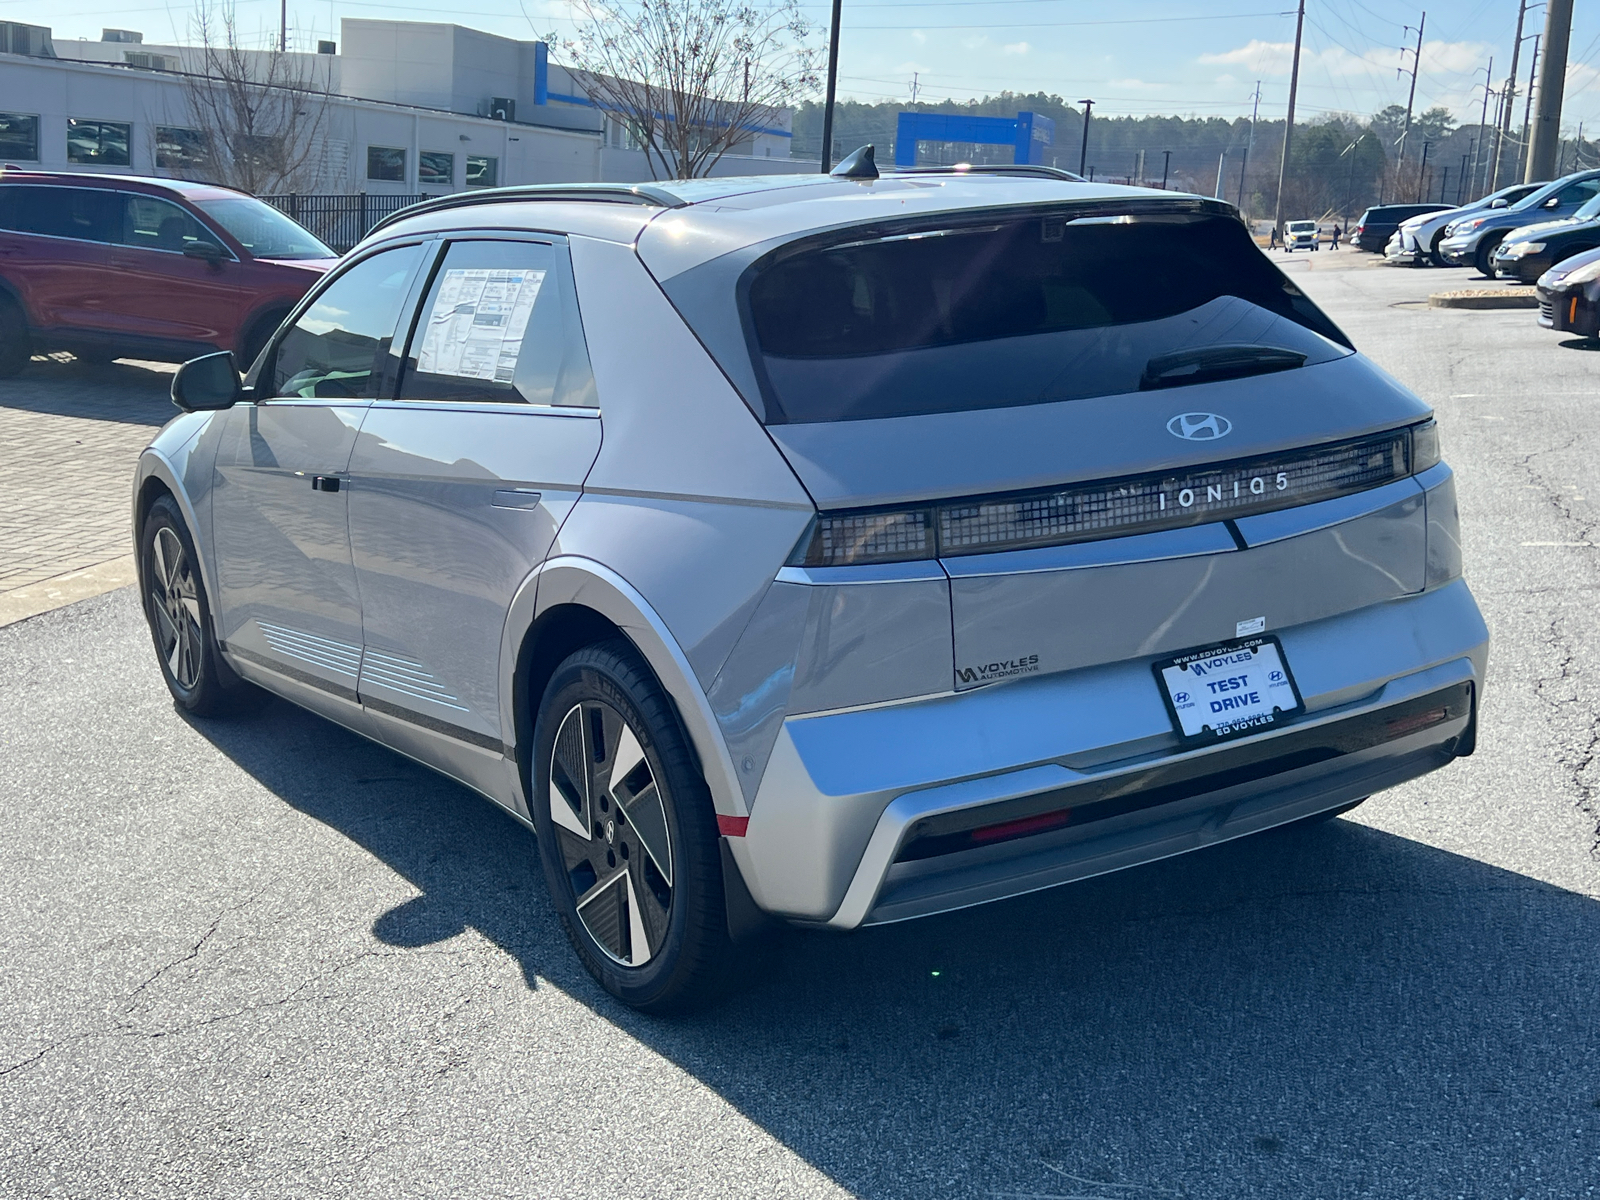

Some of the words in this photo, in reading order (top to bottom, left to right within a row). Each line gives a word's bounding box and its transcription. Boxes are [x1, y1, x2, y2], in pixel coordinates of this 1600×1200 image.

[1160, 477, 1264, 510] IONIQ
[1276, 472, 1288, 491] 5
[977, 654, 1039, 674] VOYLES
[1204, 651, 1252, 669] VOYLES
[980, 665, 1038, 680] AUTOMOTIVE
[1207, 675, 1248, 694] TEST
[1210, 691, 1260, 713] DRIVE
[1216, 726, 1231, 736] ED
[1233, 715, 1274, 730] VOYLES
